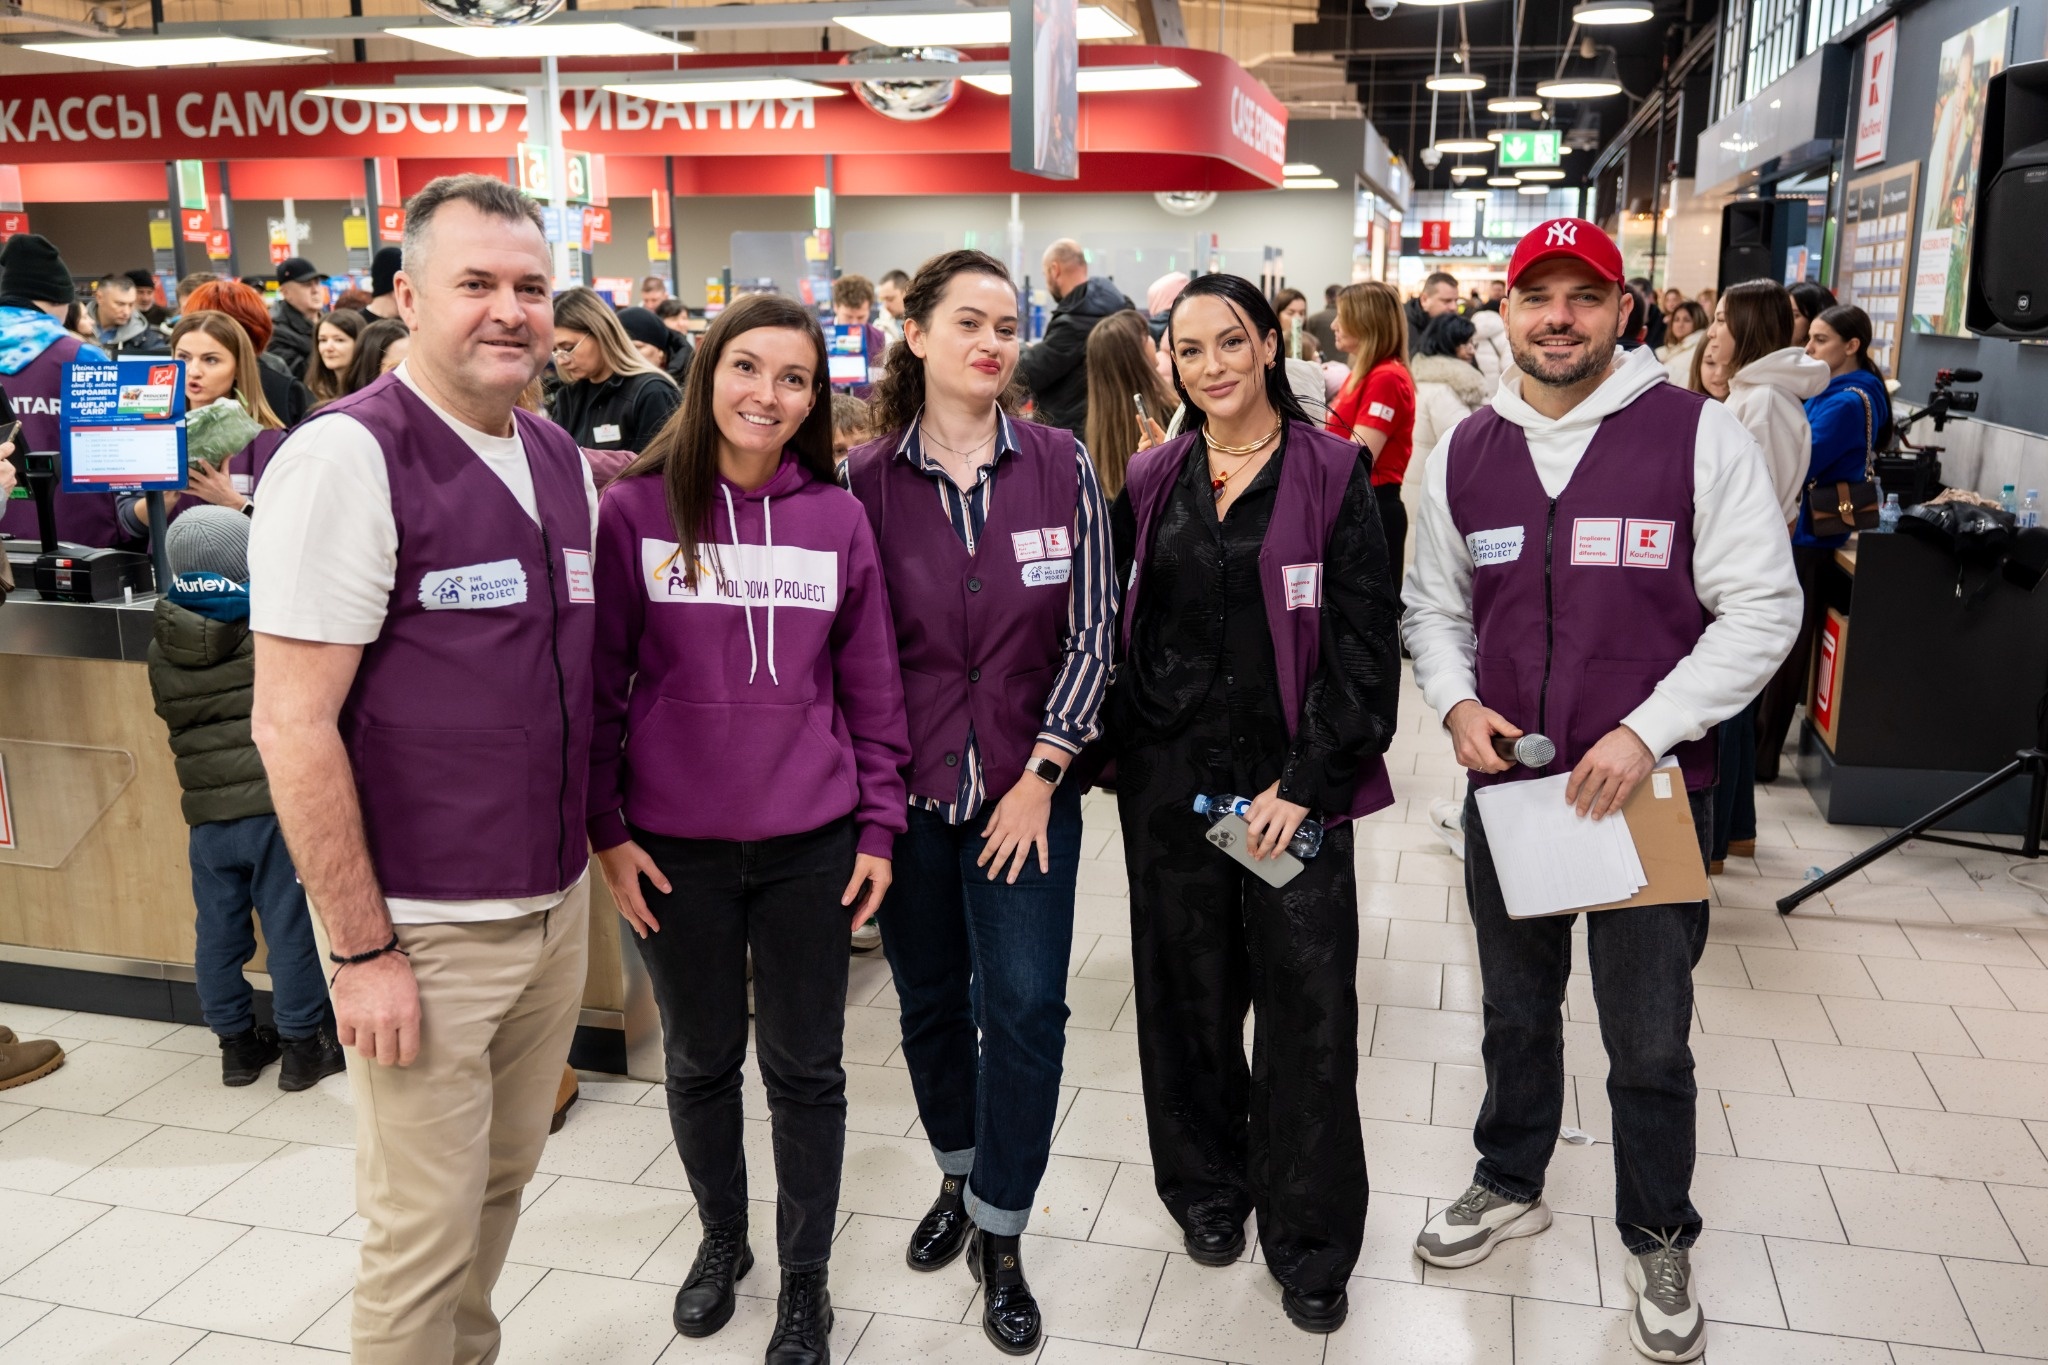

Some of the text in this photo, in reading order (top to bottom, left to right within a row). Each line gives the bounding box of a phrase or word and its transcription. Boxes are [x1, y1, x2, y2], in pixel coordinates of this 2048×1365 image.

[0, 90, 815, 142] КАССЫ САМООБСЛУИВАНИЯ
[72, 371, 118, 382] IEFTIN
[71, 401, 117, 409] KAUFLAND
[1478, 541, 1517, 552] MOLDOVA
[1479, 549, 1512, 559] PROJECT
[1629, 550, 1664, 560] Kaufland
[174, 576, 226, 593] Hurley
[470, 577, 519, 592] MOLDOVA
[471, 587, 516, 602] PROJECT
